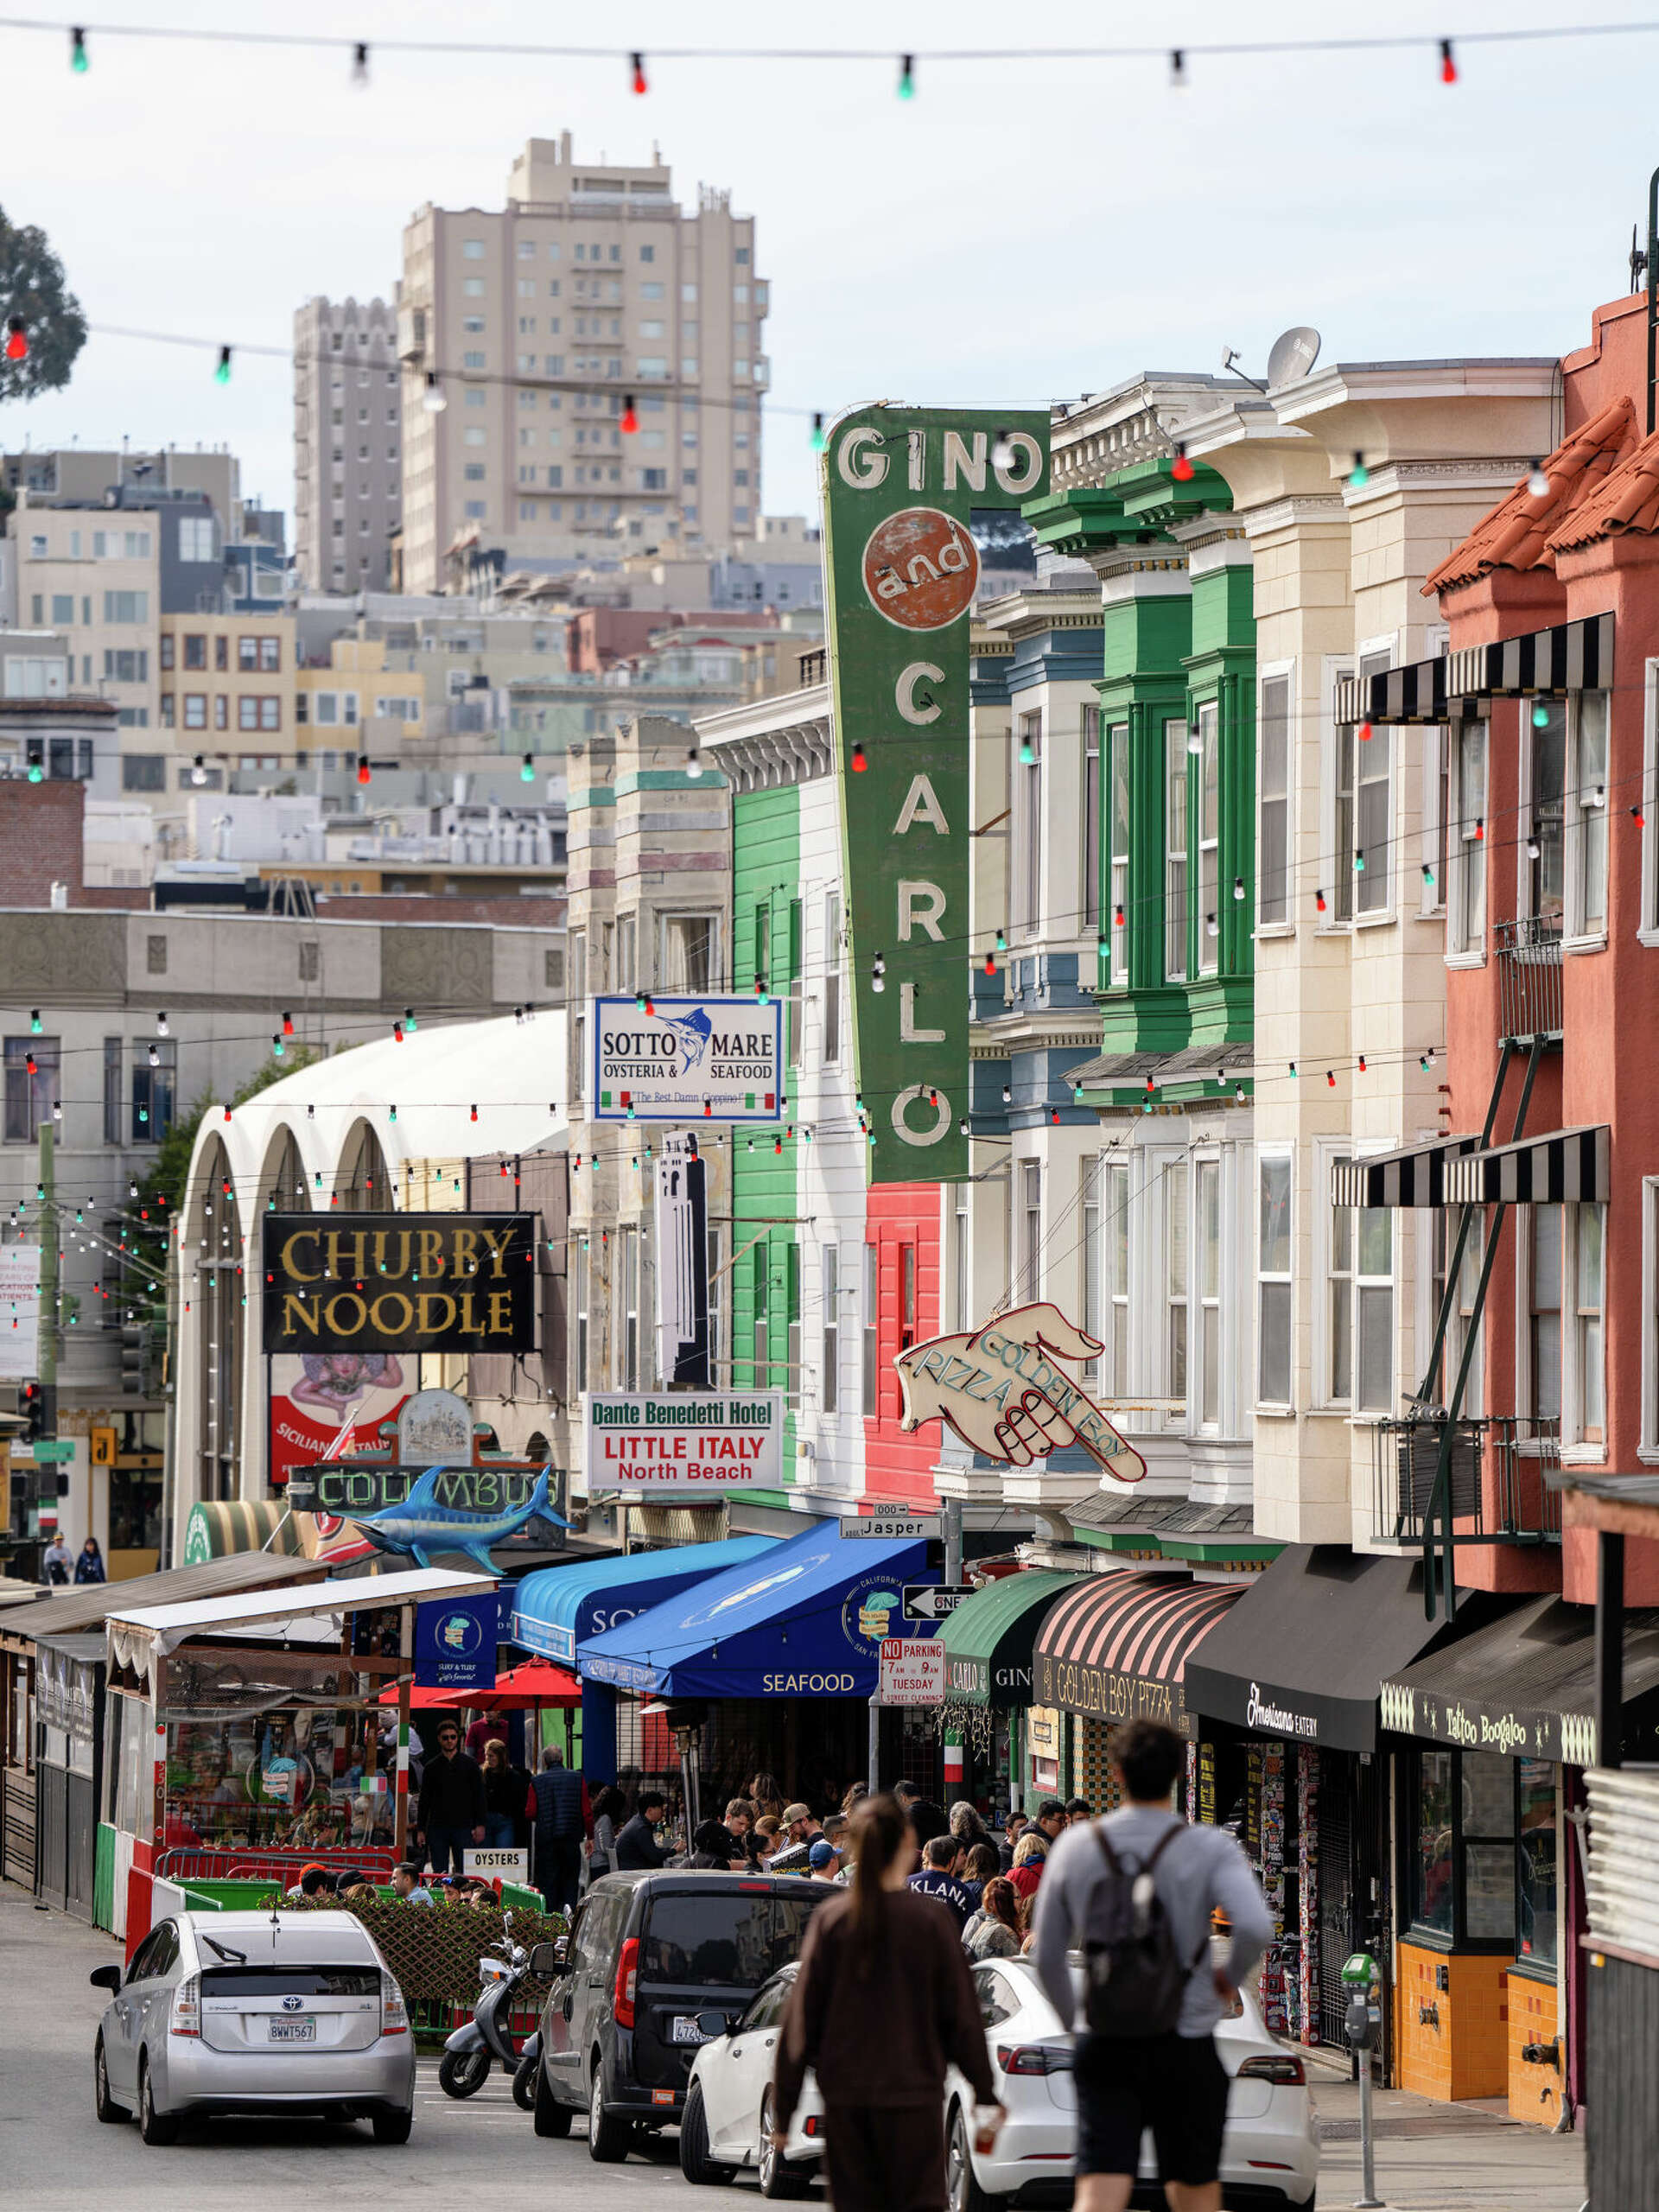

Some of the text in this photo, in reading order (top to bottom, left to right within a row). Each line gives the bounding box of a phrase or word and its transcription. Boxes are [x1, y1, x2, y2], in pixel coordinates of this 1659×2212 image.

[838, 427, 1043, 495] GINO
[874, 518, 969, 600] and
[891, 661, 952, 1147] CARLO
[603, 1033, 772, 1057] SOTTO MARE
[604, 1064, 772, 1079] OYSTERIA & SEAFOOD
[654, 1091, 671, 1103] Best
[675, 1091, 699, 1103] Damn
[280, 1228, 518, 1281] CHUBBY
[282, 1290, 513, 1337] NOODLE
[913, 1349, 1013, 1412] PIZZA
[980, 1331, 1128, 1459] GOLDEN BOY
[593, 1402, 772, 1425] Dante Benedetti Hotel
[276, 1421, 330, 1453] SICILIAN
[605, 1437, 765, 1459] LITTLE ITALY
[619, 1463, 752, 1479] North Beach
[864, 1521, 923, 1536] Jasper
[934, 1596, 962, 1609] ONE
[885, 1641, 942, 1658] NO PARKING
[763, 1674, 855, 1692] SEAFOOD
[893, 1679, 933, 1690] TUESDAY
[995, 1667, 1033, 1687] GIN
[1057, 1662, 1107, 1714] GOLDEN
[1109, 1674, 1136, 1720] BOY
[1139, 1680, 1173, 1727] PIZZA
[1294, 1715, 1318, 1738] EATERY
[1446, 1701, 1526, 1754] Tattoo Boogaloo
[475, 1853, 519, 1866] OYSTERS
[270, 2025, 313, 2037] 8WWT567
